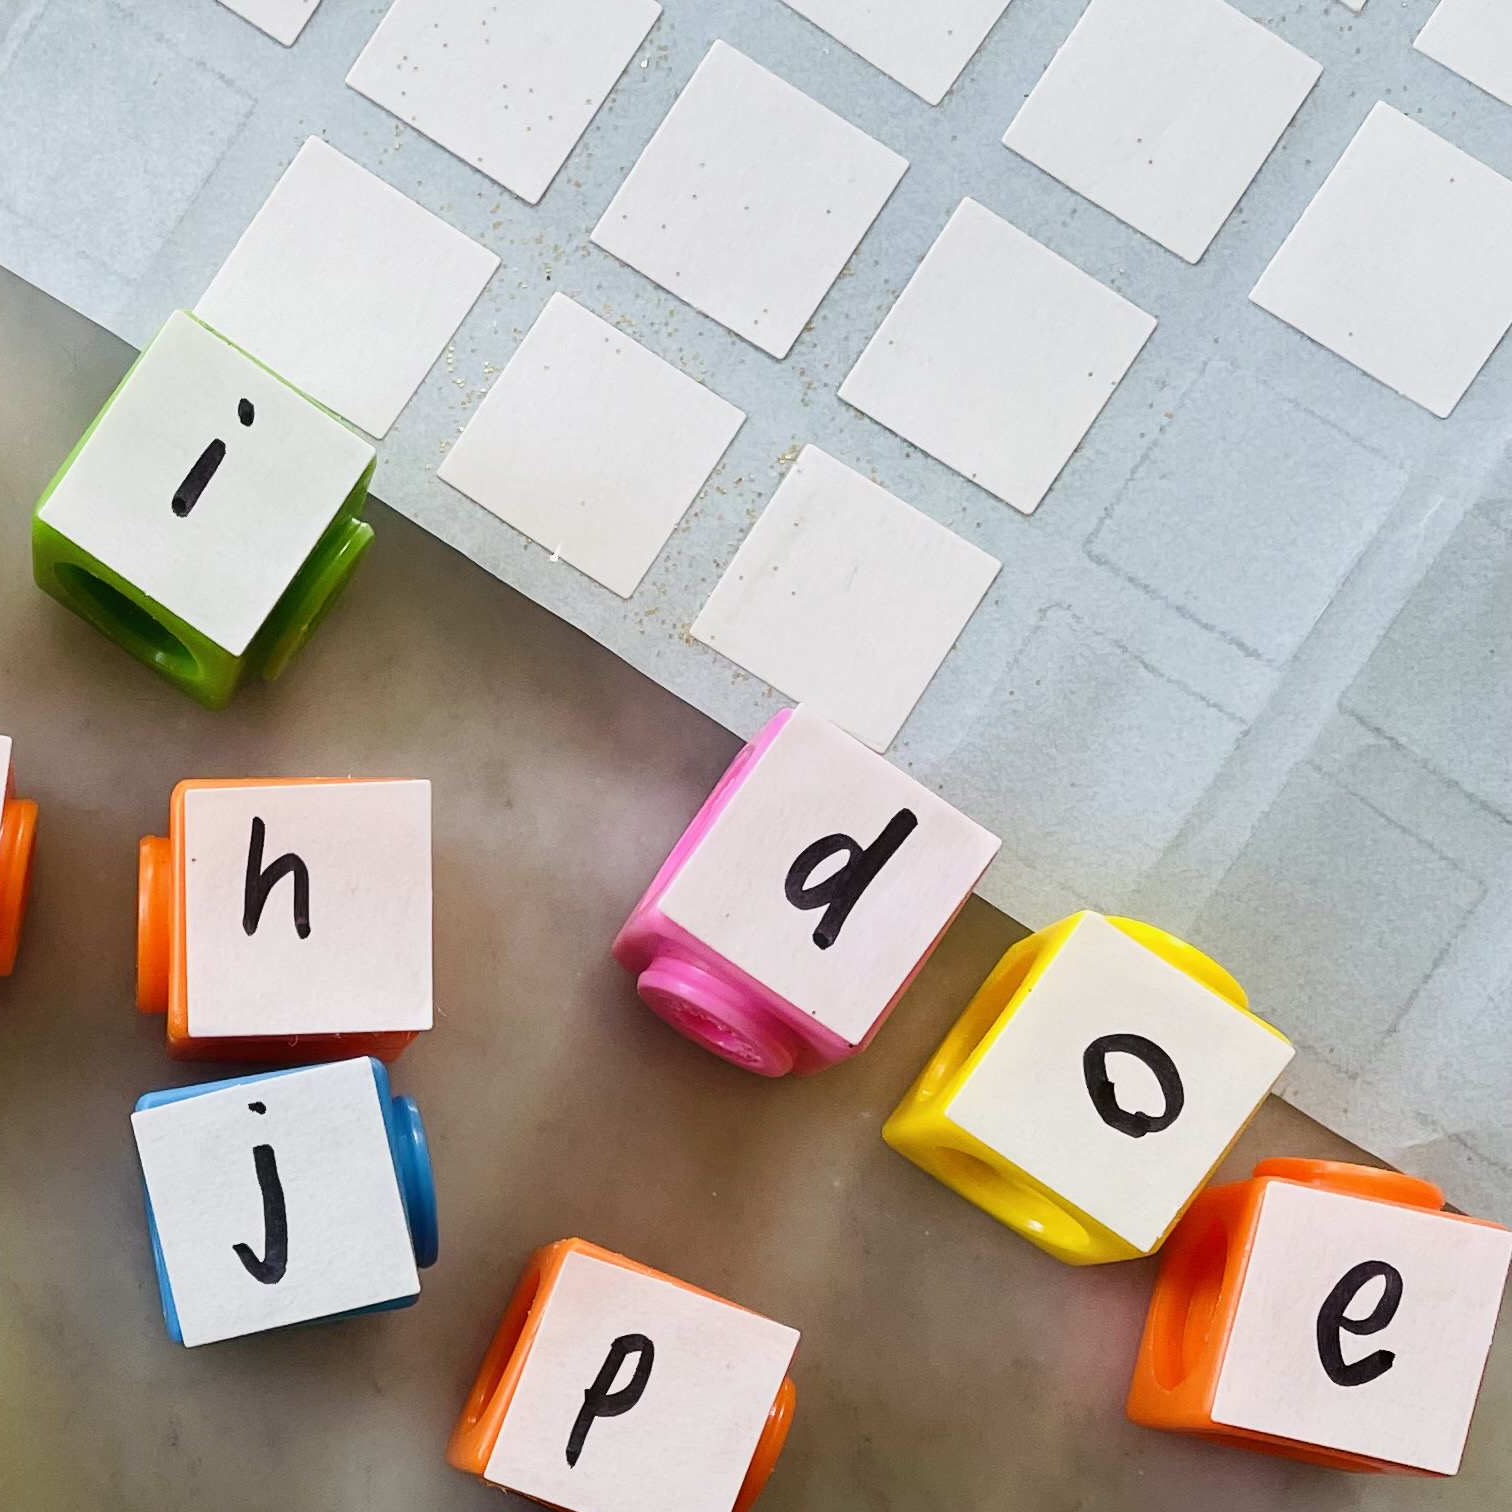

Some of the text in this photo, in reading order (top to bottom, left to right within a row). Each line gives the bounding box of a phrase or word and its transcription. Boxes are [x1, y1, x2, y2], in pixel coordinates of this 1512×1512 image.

[171, 397, 256, 518] i
[242, 816, 311, 940] h
[784, 807, 919, 951] d
[1083, 1033, 1185, 1138] o
[232, 1101, 289, 1285] j
[1316, 1260, 1404, 1387] e
[566, 1333, 655, 1469] p
